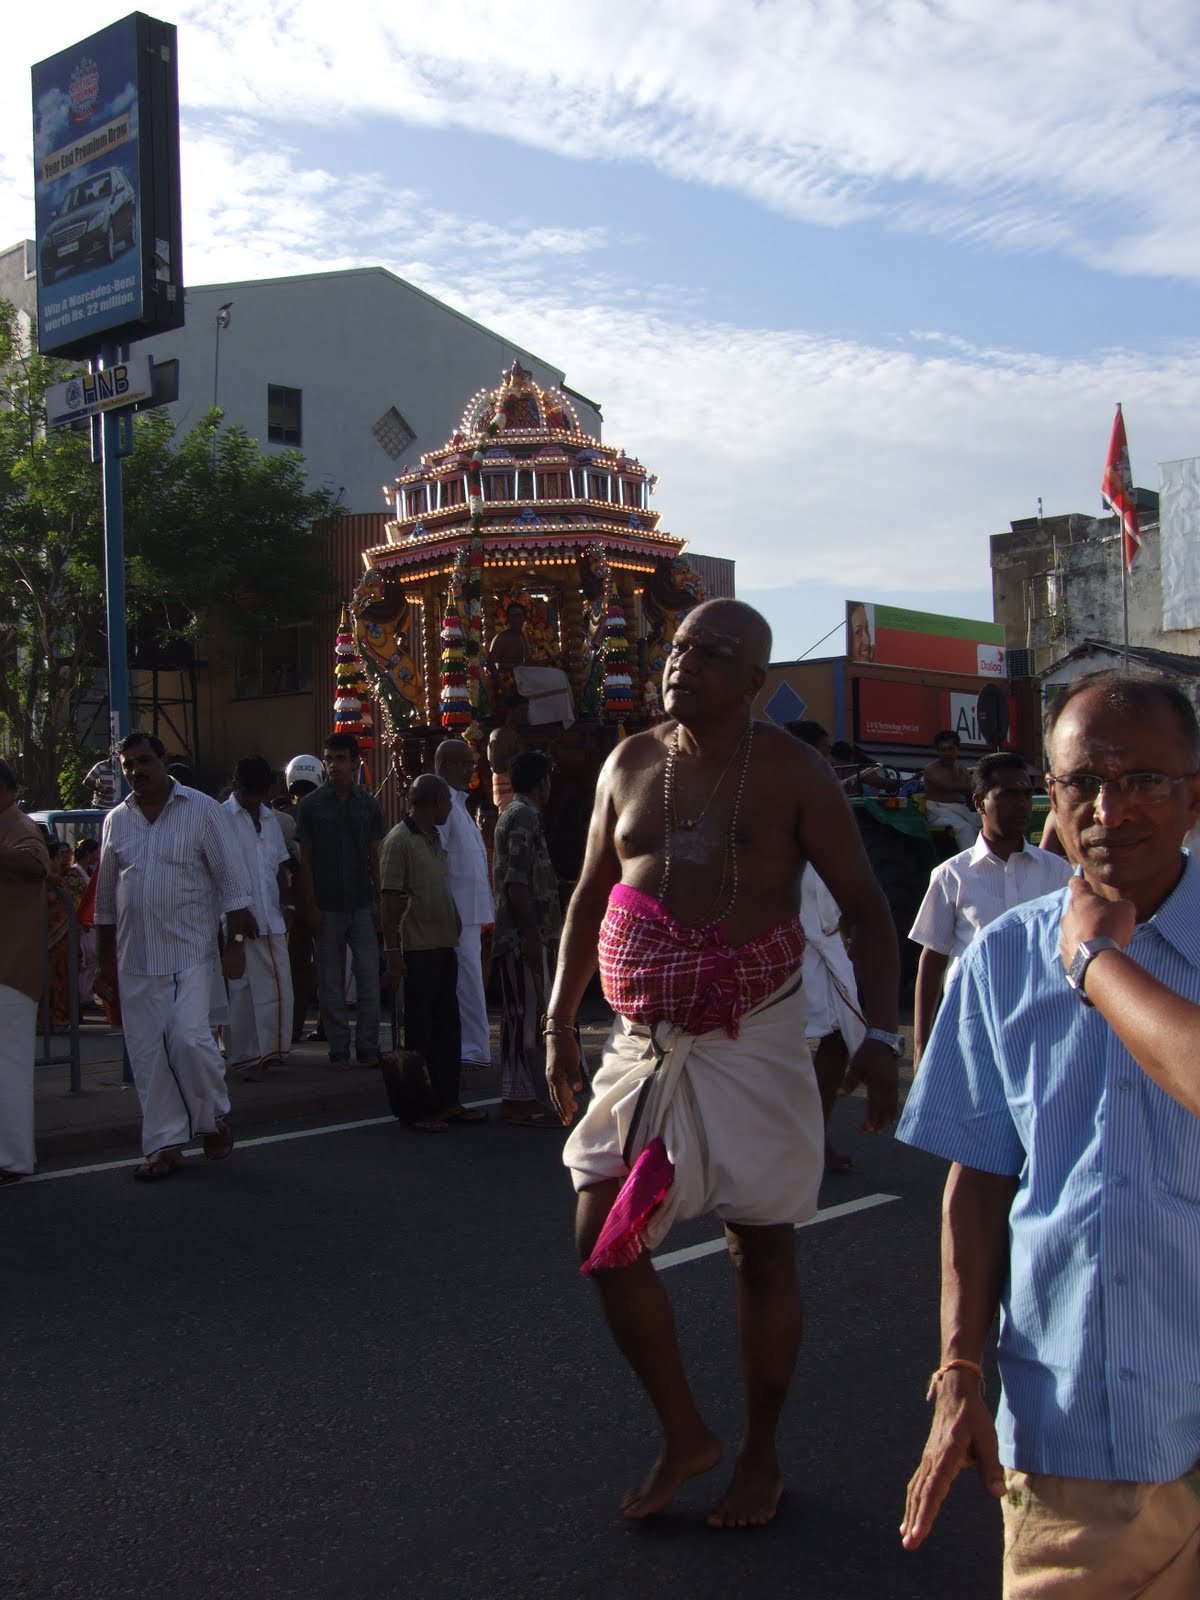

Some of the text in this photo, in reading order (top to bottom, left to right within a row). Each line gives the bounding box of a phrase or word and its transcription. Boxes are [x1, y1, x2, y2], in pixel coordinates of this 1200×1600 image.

[44, 121, 127, 178] Year End Premium Draw
[44, 303, 60, 318] Win
[69, 275, 136, 307] Mercedes-Benz
[44, 313, 71, 332] worth
[87, 302, 99, 316] 22
[82, 365, 129, 405] HNB
[980, 659, 1002, 673] Dialog
[293, 764, 316, 772] POLICE
